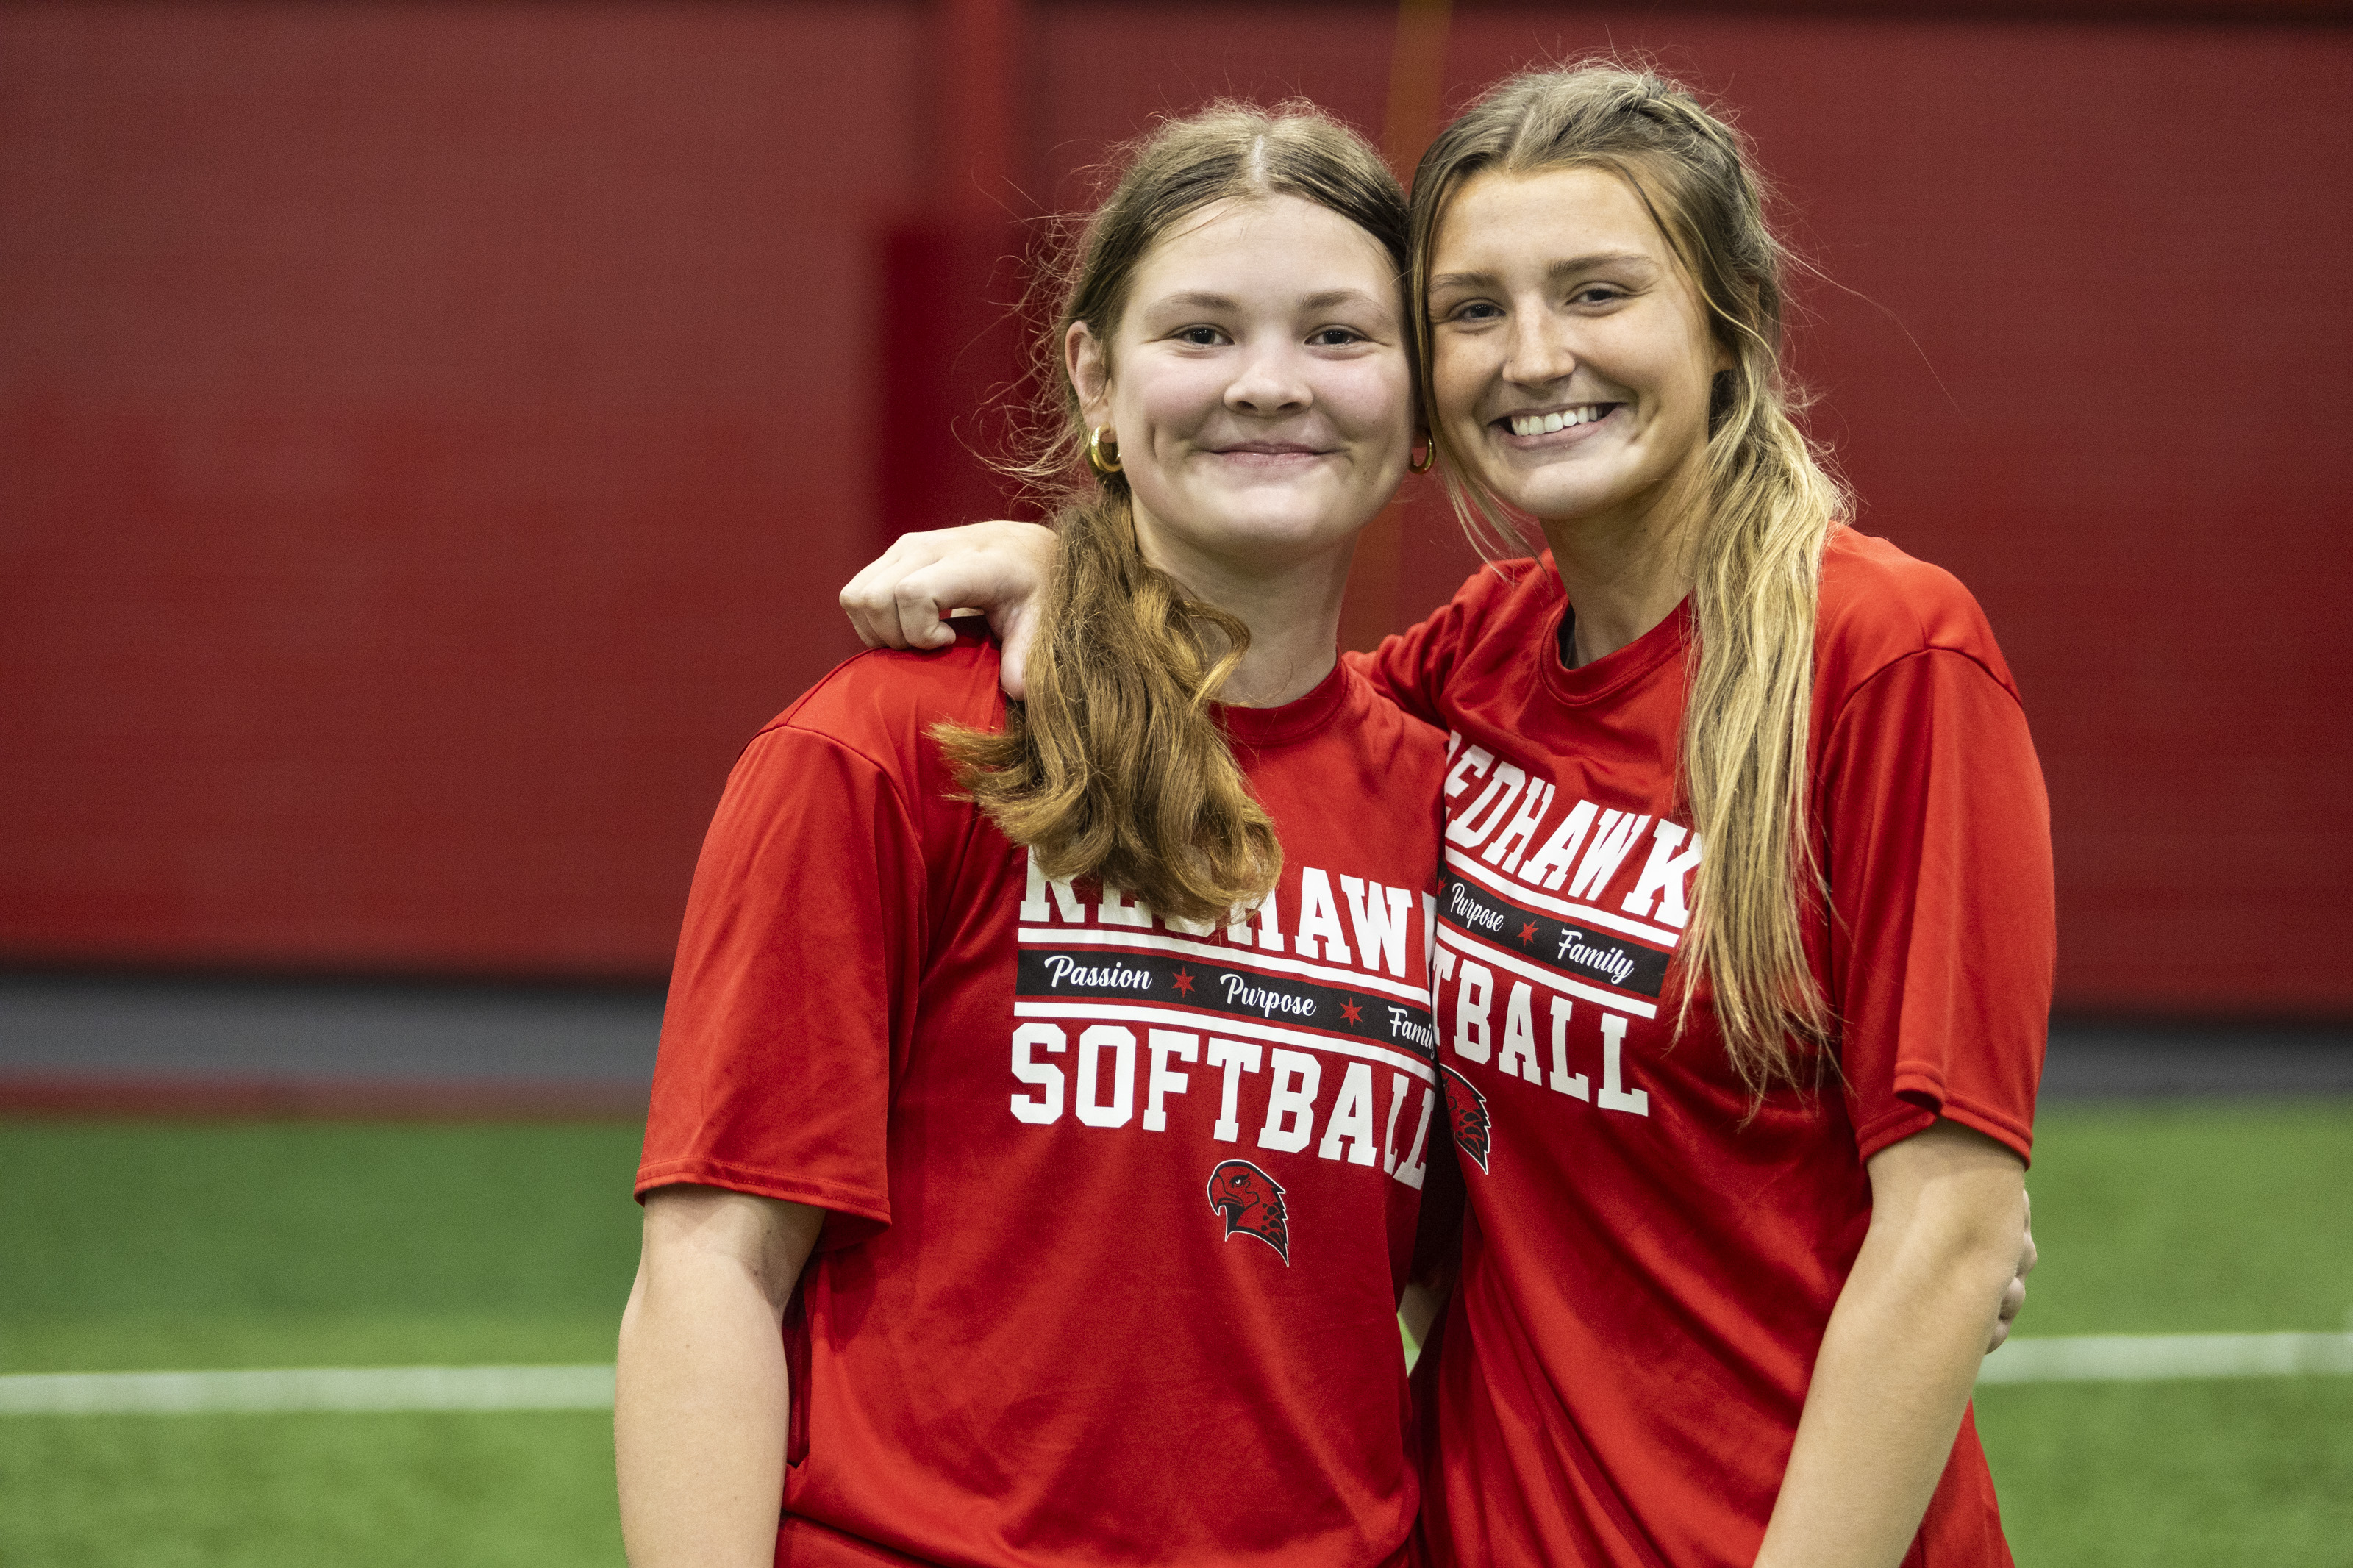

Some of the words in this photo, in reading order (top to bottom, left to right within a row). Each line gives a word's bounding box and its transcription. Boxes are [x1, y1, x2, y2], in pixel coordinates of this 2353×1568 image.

[1445, 729, 1703, 928] EDHAWK
[1044, 956, 1152, 989] Passion
[1220, 974, 1316, 1017] Purpose
[1452, 883, 1503, 932] Purpose
[1558, 928, 1633, 984] Family
[1010, 1023, 1435, 1190] SOFTBALL
[1432, 942, 1649, 1116] TBALL
